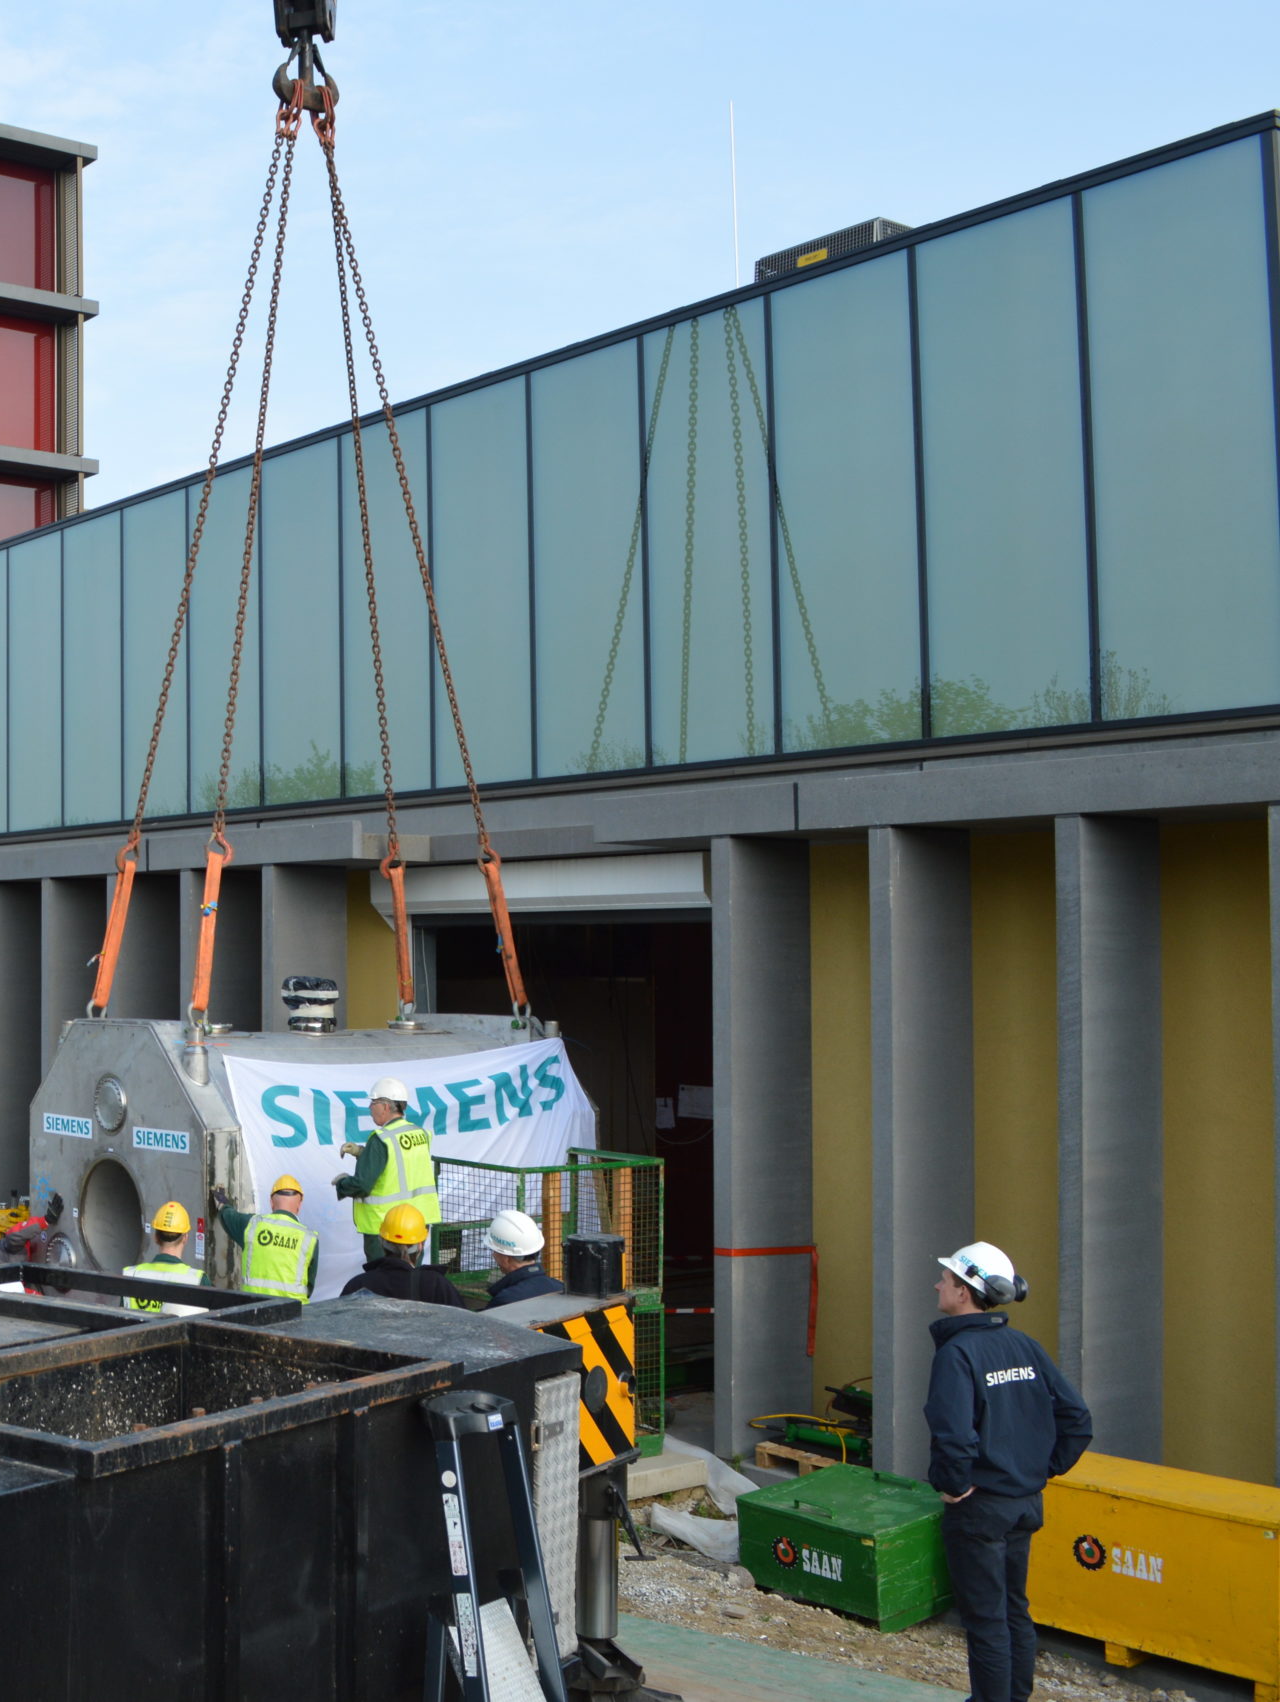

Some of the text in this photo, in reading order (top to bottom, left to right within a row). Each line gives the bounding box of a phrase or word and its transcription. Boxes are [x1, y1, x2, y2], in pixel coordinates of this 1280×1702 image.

[260, 1054, 567, 1148] SIEMENS
[45, 1115, 91, 1136] SIEMENS
[135, 1130, 187, 1151] SIEMENS
[272, 1234, 299, 1250] SAAN
[985, 1366, 1036, 1387] SIEMENS
[802, 1547, 843, 1582] SAAN
[1111, 1546, 1164, 1584] SAAN
